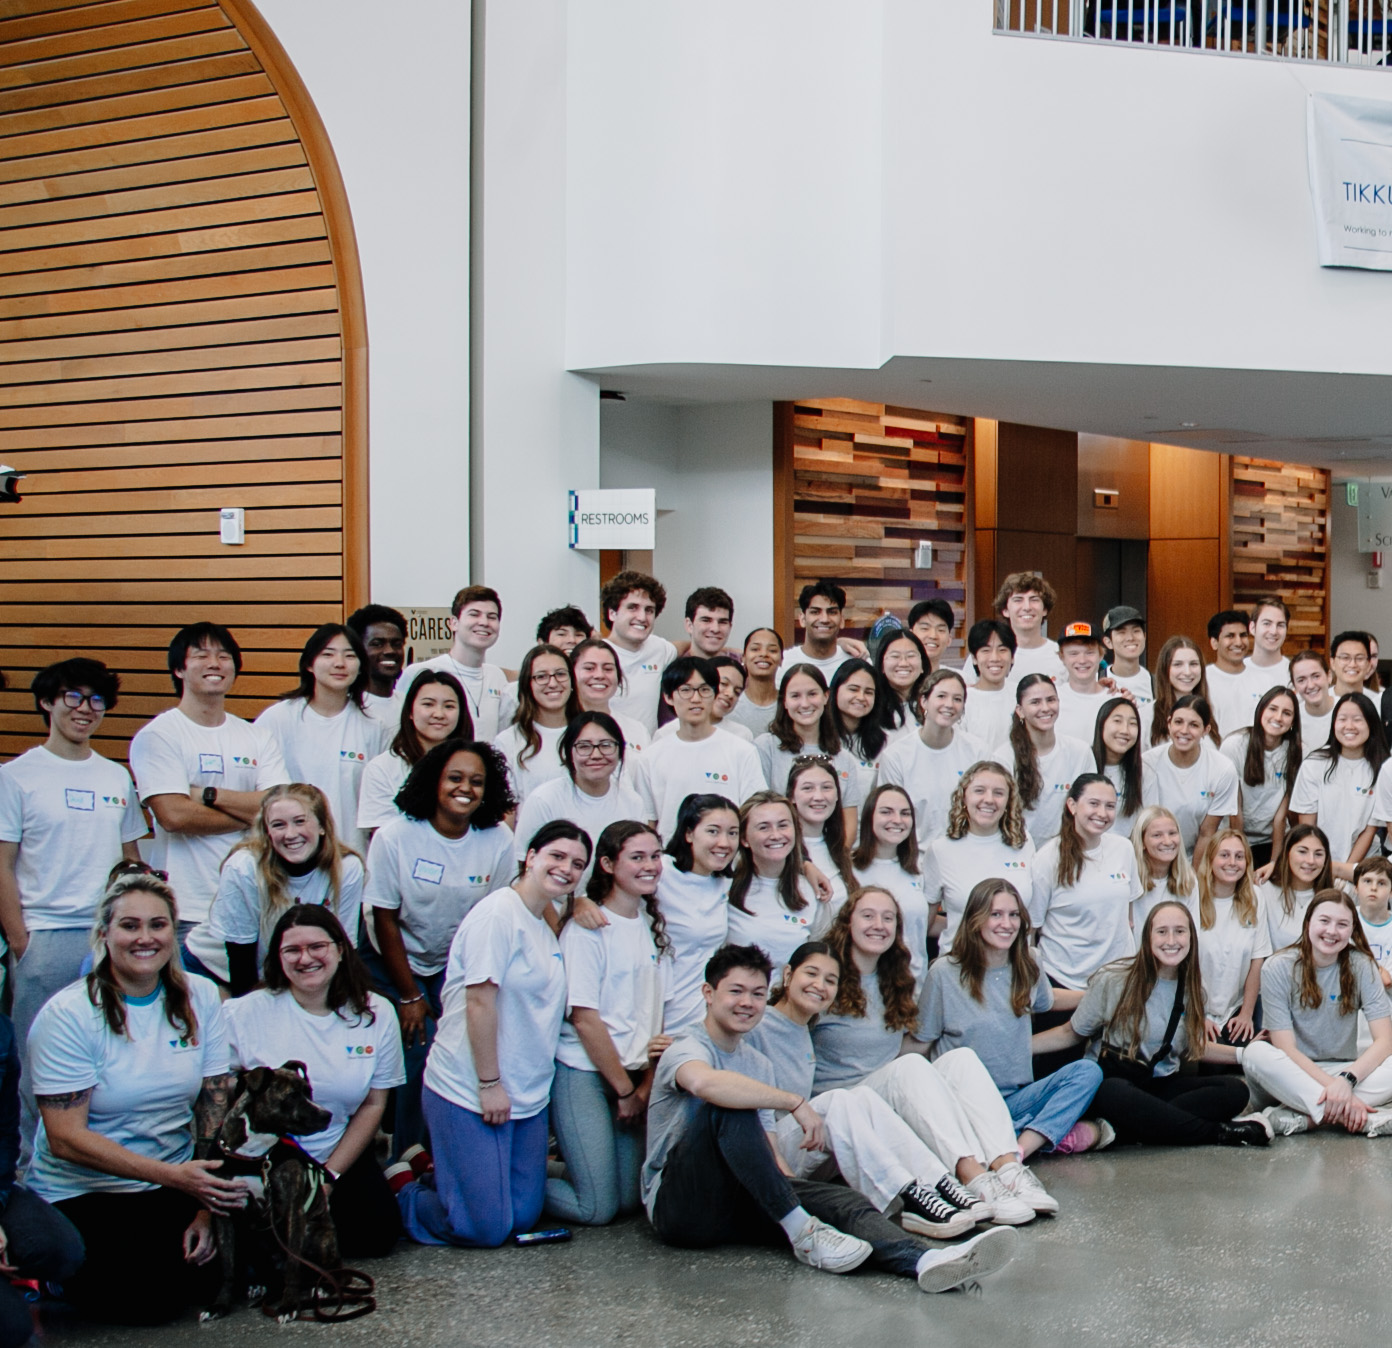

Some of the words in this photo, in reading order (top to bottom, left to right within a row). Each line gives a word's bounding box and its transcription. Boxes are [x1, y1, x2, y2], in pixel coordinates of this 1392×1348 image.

[1343, 225, 1377, 237] Working
[1379, 228, 1388, 237] to
[581, 512, 650, 525] RESTROOMS
[410, 617, 453, 640] CARES
